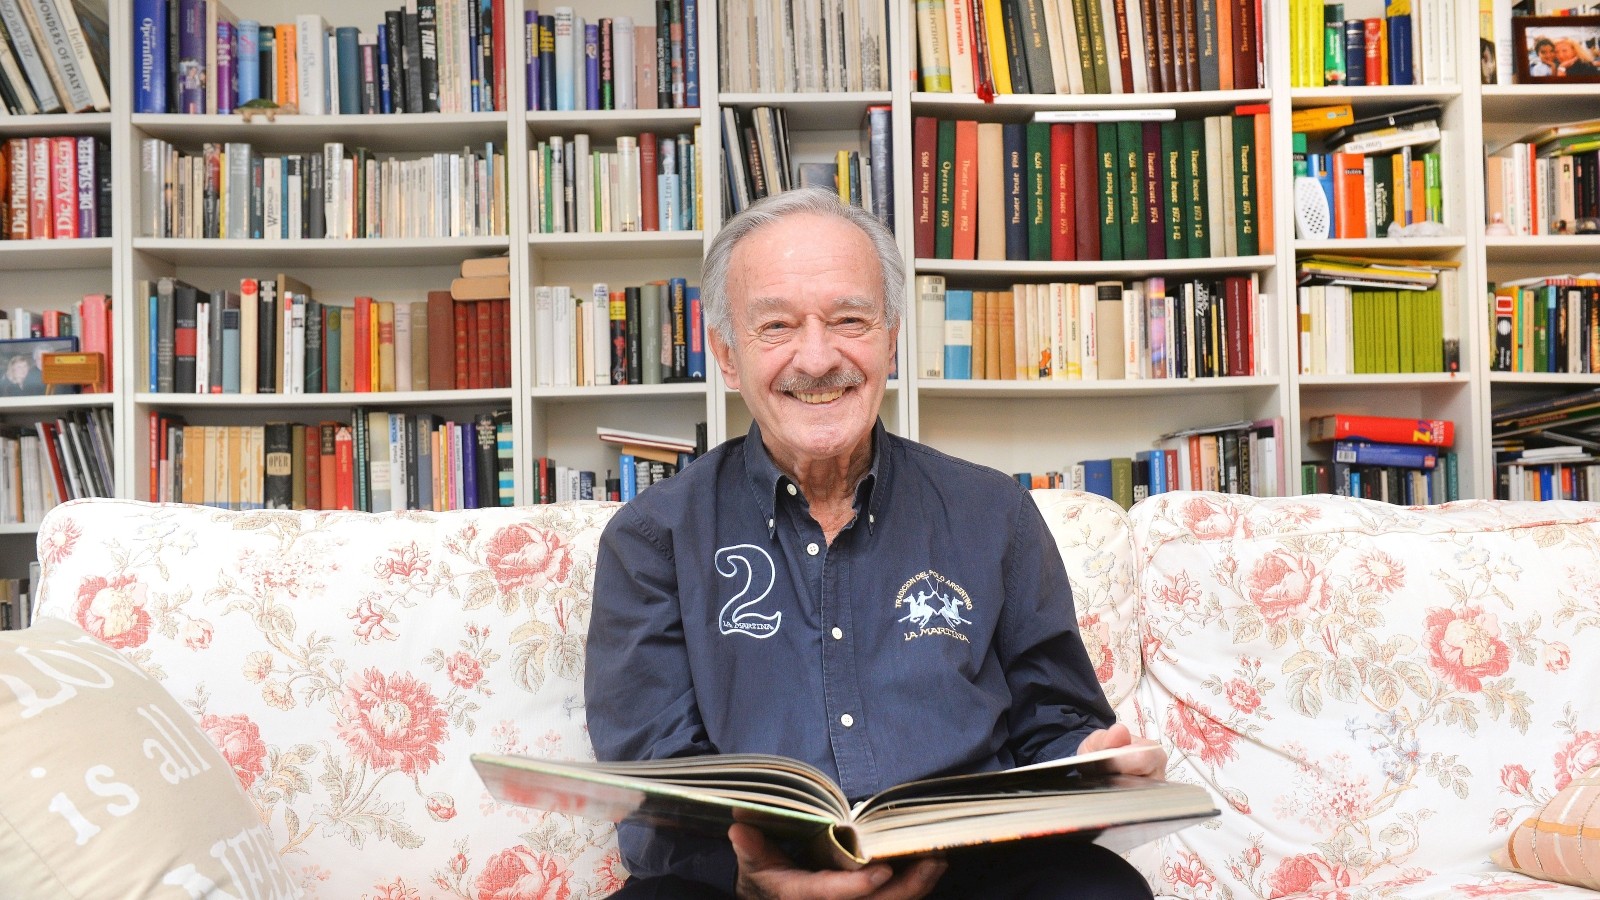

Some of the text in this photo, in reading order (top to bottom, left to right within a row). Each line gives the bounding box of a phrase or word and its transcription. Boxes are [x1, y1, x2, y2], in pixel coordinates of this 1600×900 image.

[39, 0, 81, 90] ONDERS OF ITALY
[929, 17, 939, 54] WILHELM
[140, 18, 153, 93] Opernführer
[1148, 151, 1156, 178] Theater
[1170, 151, 1178, 179] Theater
[1191, 150, 1200, 177] Theater
[1241, 145, 1249, 172] Theater
[55, 140, 72, 231] Die Azteken
[78, 136, 93, 210] DIE STAUFER
[962, 160, 970, 186] Theater
[1012, 172, 1020, 195] heute
[1035, 172, 1043, 195] heute
[1059, 163, 1067, 189] Theater
[1105, 172, 1113, 195] heute
[1130, 171, 1138, 194] heute
[1242, 174, 1250, 197] heute
[32, 180, 46, 200] Die
[920, 151, 929, 224] Theater heute 1985
[941, 161, 951, 227] Opernwelt 1975
[962, 189, 970, 211] heute
[1148, 180, 1157, 204] heute
[1170, 181, 1179, 203] heute
[1192, 179, 1200, 201] heute
[1012, 197, 1020, 225] Theater
[1035, 197, 1043, 225] Theater
[1059, 192, 1067, 214] heute
[1106, 197, 1114, 225] Theater
[1131, 196, 1139, 224] Theater
[12, 210, 27, 233] Die
[673, 284, 683, 312] Heesters
[674, 314, 686, 345] Johannes
[269, 455, 288, 467] OPER
[1242, 444, 1250, 495] HOLLYWOO
[715, 543, 782, 639] 2
[895, 569, 973, 610] TRADICION DEL POLO ARGENTINO
[723, 620, 774, 630] LA MARTINA
[904, 627, 971, 643] LA MARTINA
[0, 636, 149, 719] LOV
[137, 703, 212, 785] all
[30, 764, 140, 846] is
